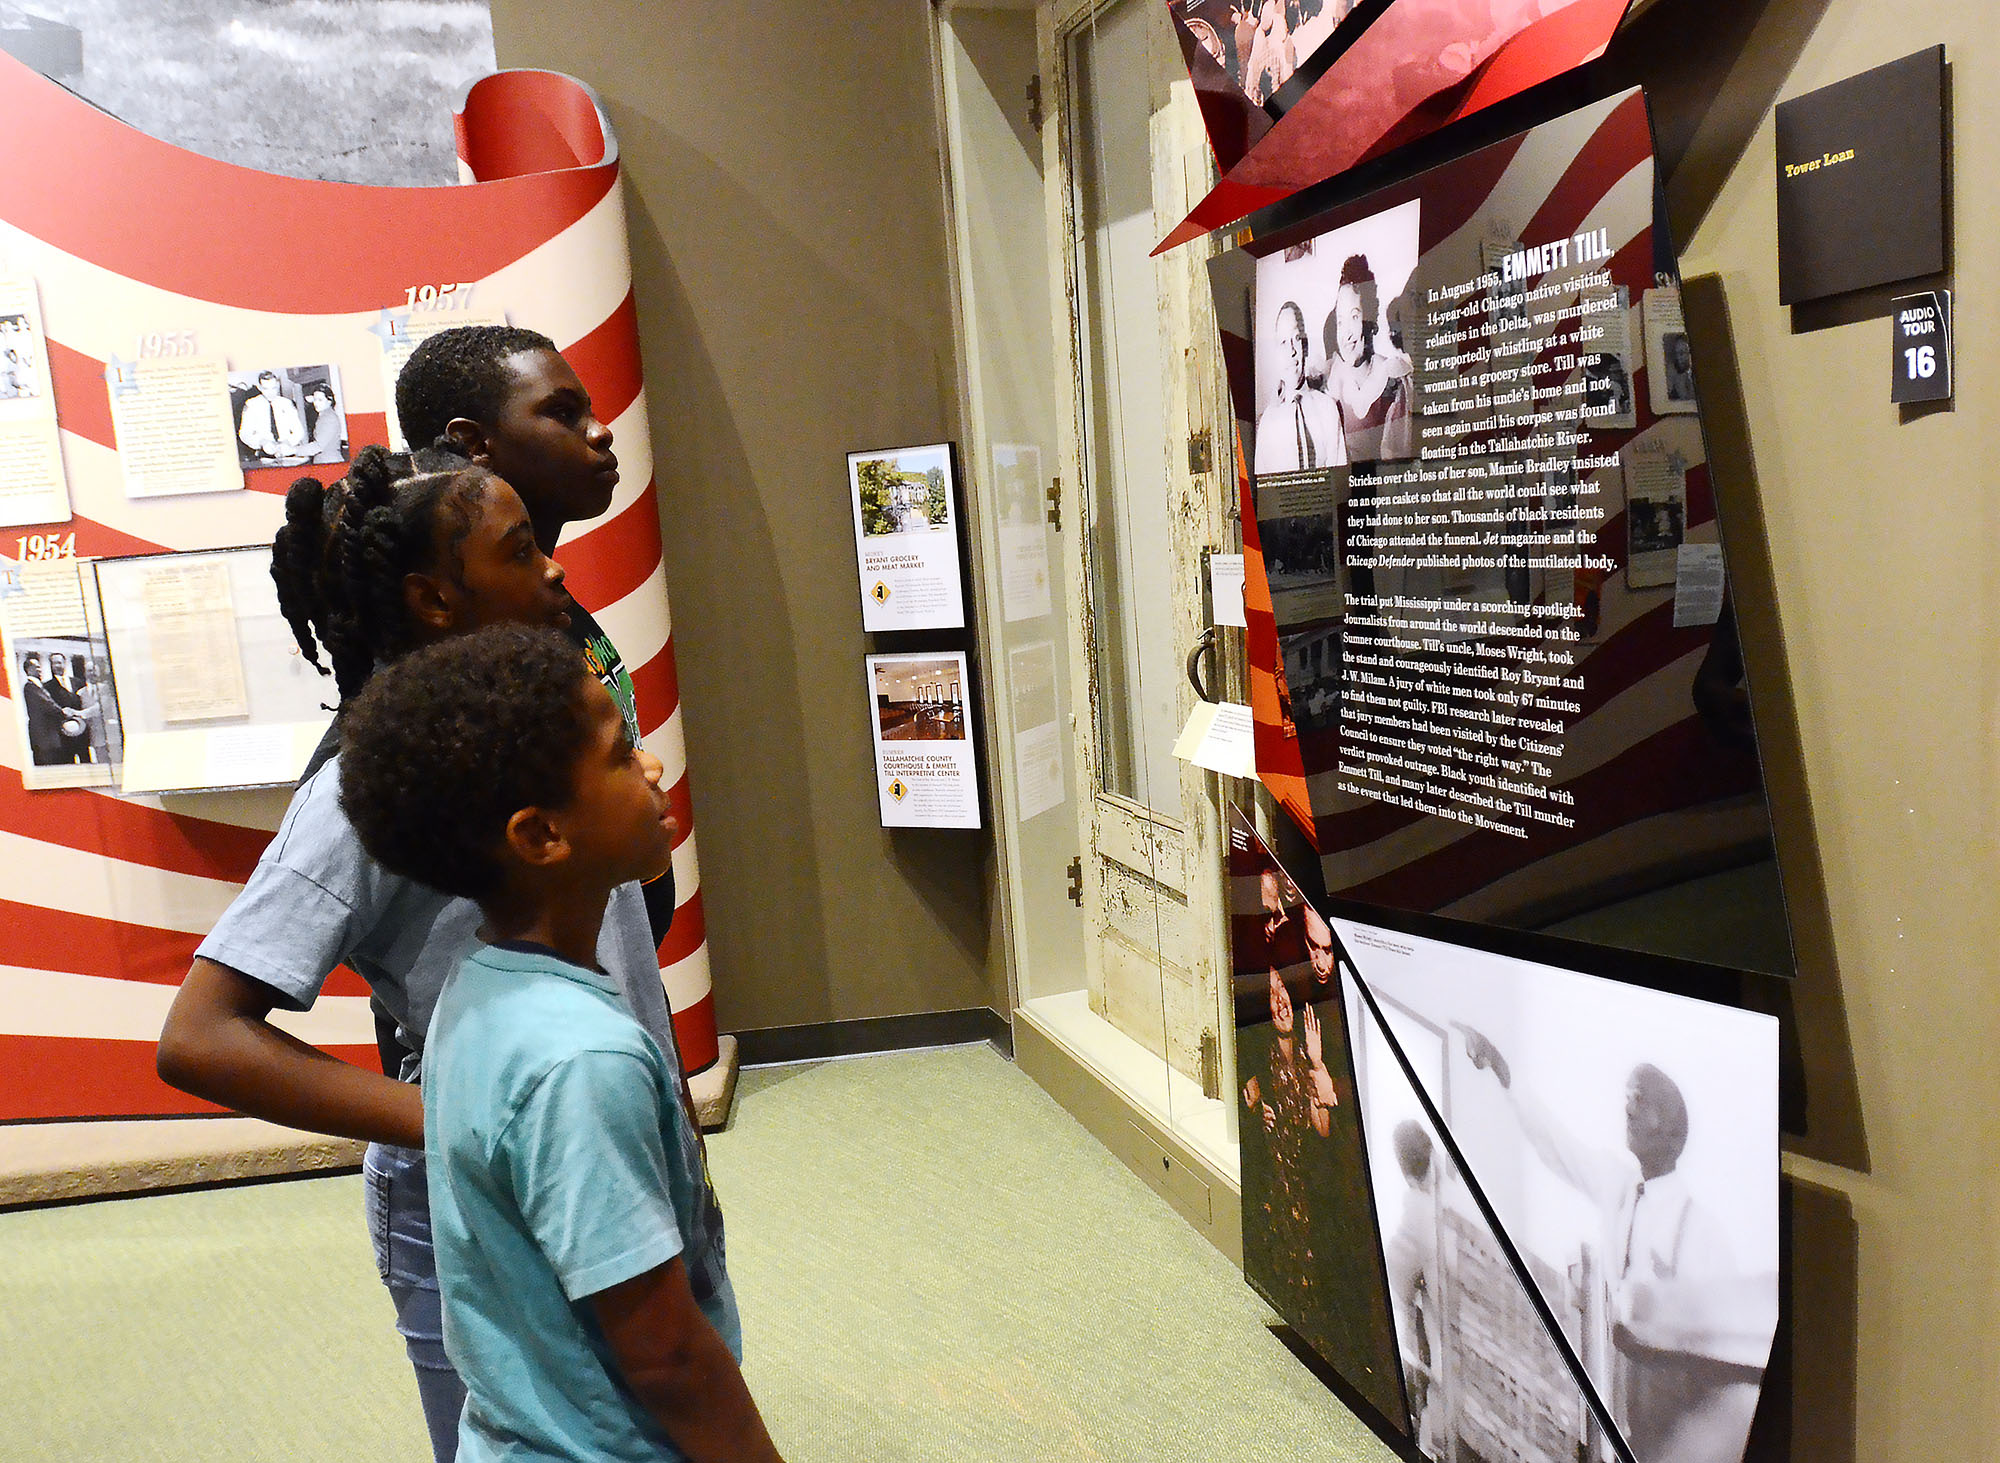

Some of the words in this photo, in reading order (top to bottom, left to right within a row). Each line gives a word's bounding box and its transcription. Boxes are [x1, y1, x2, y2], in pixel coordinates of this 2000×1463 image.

[1784, 157, 1821, 178] Tower
[1823, 148, 1855, 166] Loan
[1428, 288, 1438, 303] In
[1440, 278, 1475, 299] August
[1474, 270, 1502, 290] 1955,
[1502, 239, 1569, 282] EMMETT
[1575, 228, 1615, 264] TILL,
[404, 282, 475, 313] 1957
[1427, 299, 1479, 326] 14-year-old
[1480, 287, 1524, 312] Chicago
[1523, 282, 1561, 302] native
[1562, 270, 1612, 292] visiting
[1425, 326, 1467, 349] relatives
[1468, 325, 1479, 339] in
[1479, 321, 1498, 336] the
[1497, 313, 1531, 333] Delta,
[1533, 310, 1555, 325] was
[1557, 292, 1617, 321] murdered
[1900, 306, 1935, 324] AUDIO
[1902, 320, 1936, 337] TOUR
[1424, 357, 1439, 371] for
[1439, 345, 1491, 369] reportedly
[1493, 335, 1544, 357] whistling
[1543, 333, 1558, 348] at
[1558, 333, 1567, 345] a
[1568, 323, 1604, 343] white
[1904, 345, 1937, 380] 16
[1424, 378, 1457, 393] woman
[1458, 373, 1469, 387] in
[1470, 375, 1478, 385] a
[1478, 367, 1519, 387] grocery
[1520, 362, 1552, 377] store.
[1553, 354, 1574, 371] Till
[1576, 353, 1601, 371] was
[1422, 400, 1449, 415] taken
[1450, 397, 1474, 412] from
[1474, 392, 1491, 408] his
[1530, 385, 1564, 400] home
[1563, 377, 1587, 395] and
[1589, 375, 1612, 391] not
[1421, 426, 1442, 438] seen
[1443, 419, 1470, 437] again
[1471, 414, 1498, 431] until
[1497, 413, 1515, 428] his
[1515, 411, 1553, 427] corpse
[1554, 408, 1577, 421] was
[1578, 398, 1618, 418] found
[1421, 444, 1456, 460] floating
[1457, 445, 1468, 456] in
[1468, 440, 1486, 454] the
[1487, 433, 1554, 453] Tallahatchie
[1556, 430, 1592, 446] River.
[1348, 473, 1382, 487] Stricken
[1383, 474, 1402, 484] over
[1403, 469, 1418, 482] the
[1419, 468, 1437, 481] loss
[1437, 466, 1448, 480] of
[1449, 465, 1467, 479] her
[1466, 467, 1487, 478] son,
[1489, 461, 1524, 476] Mamie
[1525, 456, 1571, 473] Bradley
[1570, 451, 1619, 472] insisted
[16, 532, 76, 561] 1954
[1346, 534, 1356, 546] of
[1355, 534, 1388, 548] Chicago
[1388, 532, 1426, 546] attended
[1426, 532, 1442, 545] the
[1443, 531, 1481, 545] funeral.
[1482, 531, 1499, 545] Jet
[1499, 531, 1551, 547] magazine
[1552, 529, 1574, 544] and
[1575, 529, 1597, 544] the
[900, 561, 925, 569] MARKET
[1346, 554, 1378, 569] Chicago
[1377, 553, 1415, 569] Defender
[1416, 553, 1460, 569] published
[1461, 553, 1495, 570] photos
[1496, 553, 1508, 568] of
[1507, 553, 1526, 567] the
[1527, 553, 1582, 570] mutilated
[1583, 553, 1617, 572] body.
[1344, 592, 1359, 605] The
[1360, 593, 1378, 606] trial
[1378, 596, 1394, 609] put
[1393, 594, 1441, 614] Mississippi
[1442, 597, 1471, 611] under
[1472, 601, 1479, 611] a
[1481, 599, 1531, 618] scorching
[1530, 601, 1585, 619] spotlight.
[1343, 612, 1387, 626] Journalists
[1387, 614, 1408, 628] from
[1409, 617, 1440, 630] around
[1441, 618, 1457, 631] the
[1458, 620, 1487, 634] world
[1487, 621, 1542, 638] descended
[1543, 628, 1558, 640] on
[1559, 626, 1580, 641] the
[1342, 631, 1372, 645] Sumner
[1373, 635, 1422, 650] courthouse.
[1445, 641, 1474, 657] uncle,
[1475, 642, 1507, 658] Moses
[1506, 645, 1546, 664] Wright,
[1547, 650, 1573, 665] took
[1342, 650, 1355, 662] the
[1355, 653, 1377, 665] stand
[1378, 655, 1394, 667] and
[1394, 659, 1451, 676] courageously
[1453, 662, 1498, 679] identified
[1500, 666, 1521, 685] Roy
[1522, 669, 1561, 687] Bryant
[1562, 675, 1584, 689] and
[1338, 745, 1365, 758] verdict
[1366, 751, 1403, 767] provoked
[1403, 759, 1439, 776] outrage.
[1440, 763, 1467, 781] Black
[1468, 773, 1496, 788] youth
[1497, 776, 1547, 799] identified
[1549, 790, 1574, 805] with
[1338, 760, 1367, 778] Emmett
[1367, 767, 1384, 784] Till,
[1384, 774, 1400, 786] and
[1401, 778, 1425, 793] many
[1426, 780, 1447, 797] later
[1448, 786, 1494, 808] described
[1494, 797, 1512, 813] the
[1513, 801, 1532, 818] Till
[1533, 809, 1575, 828] murder
